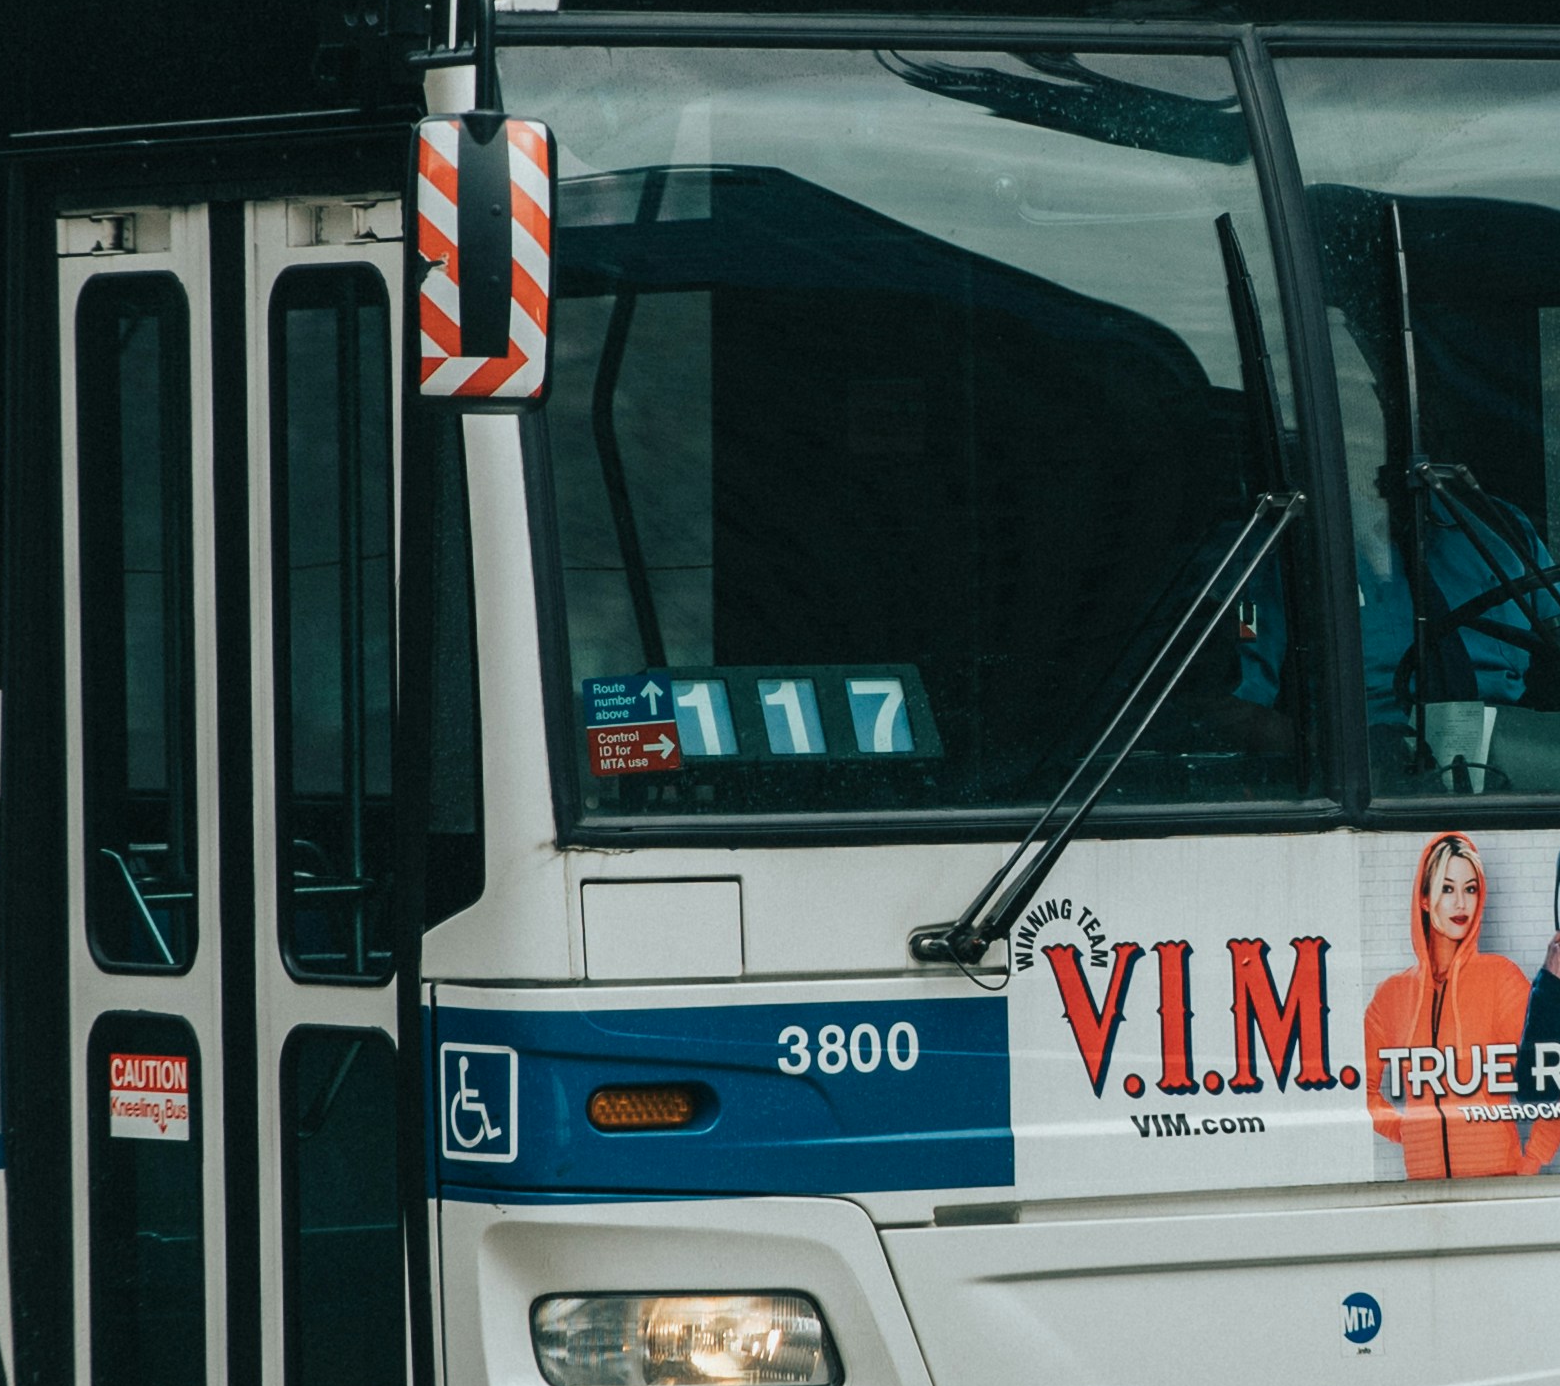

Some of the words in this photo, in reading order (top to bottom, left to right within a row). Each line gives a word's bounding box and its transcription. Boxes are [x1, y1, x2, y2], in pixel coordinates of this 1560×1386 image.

[593, 682, 626, 695] Route
[594, 695, 637, 708] number
[595, 709, 630, 720] above
[597, 730, 640, 744] Control
[599, 746, 612, 757] ID
[615, 745, 632, 756] for
[600, 758, 627, 770] MTA
[628, 758, 649, 769] use
[1014, 898, 1073, 973] WINNING
[1076, 906, 1109, 969] TEAM
[1040, 935, 1364, 1100] V.I.M.
[776, 1021, 921, 1077] 3800
[110, 1058, 188, 1091] CAUTION
[1379, 1043, 1519, 1100] TRUE
[110, 1097, 161, 1121] Kneeling
[165, 1097, 188, 1121] Bus
[1130, 1112, 1266, 1139] VIM.com
[1342, 1304, 1376, 1334] MTA
